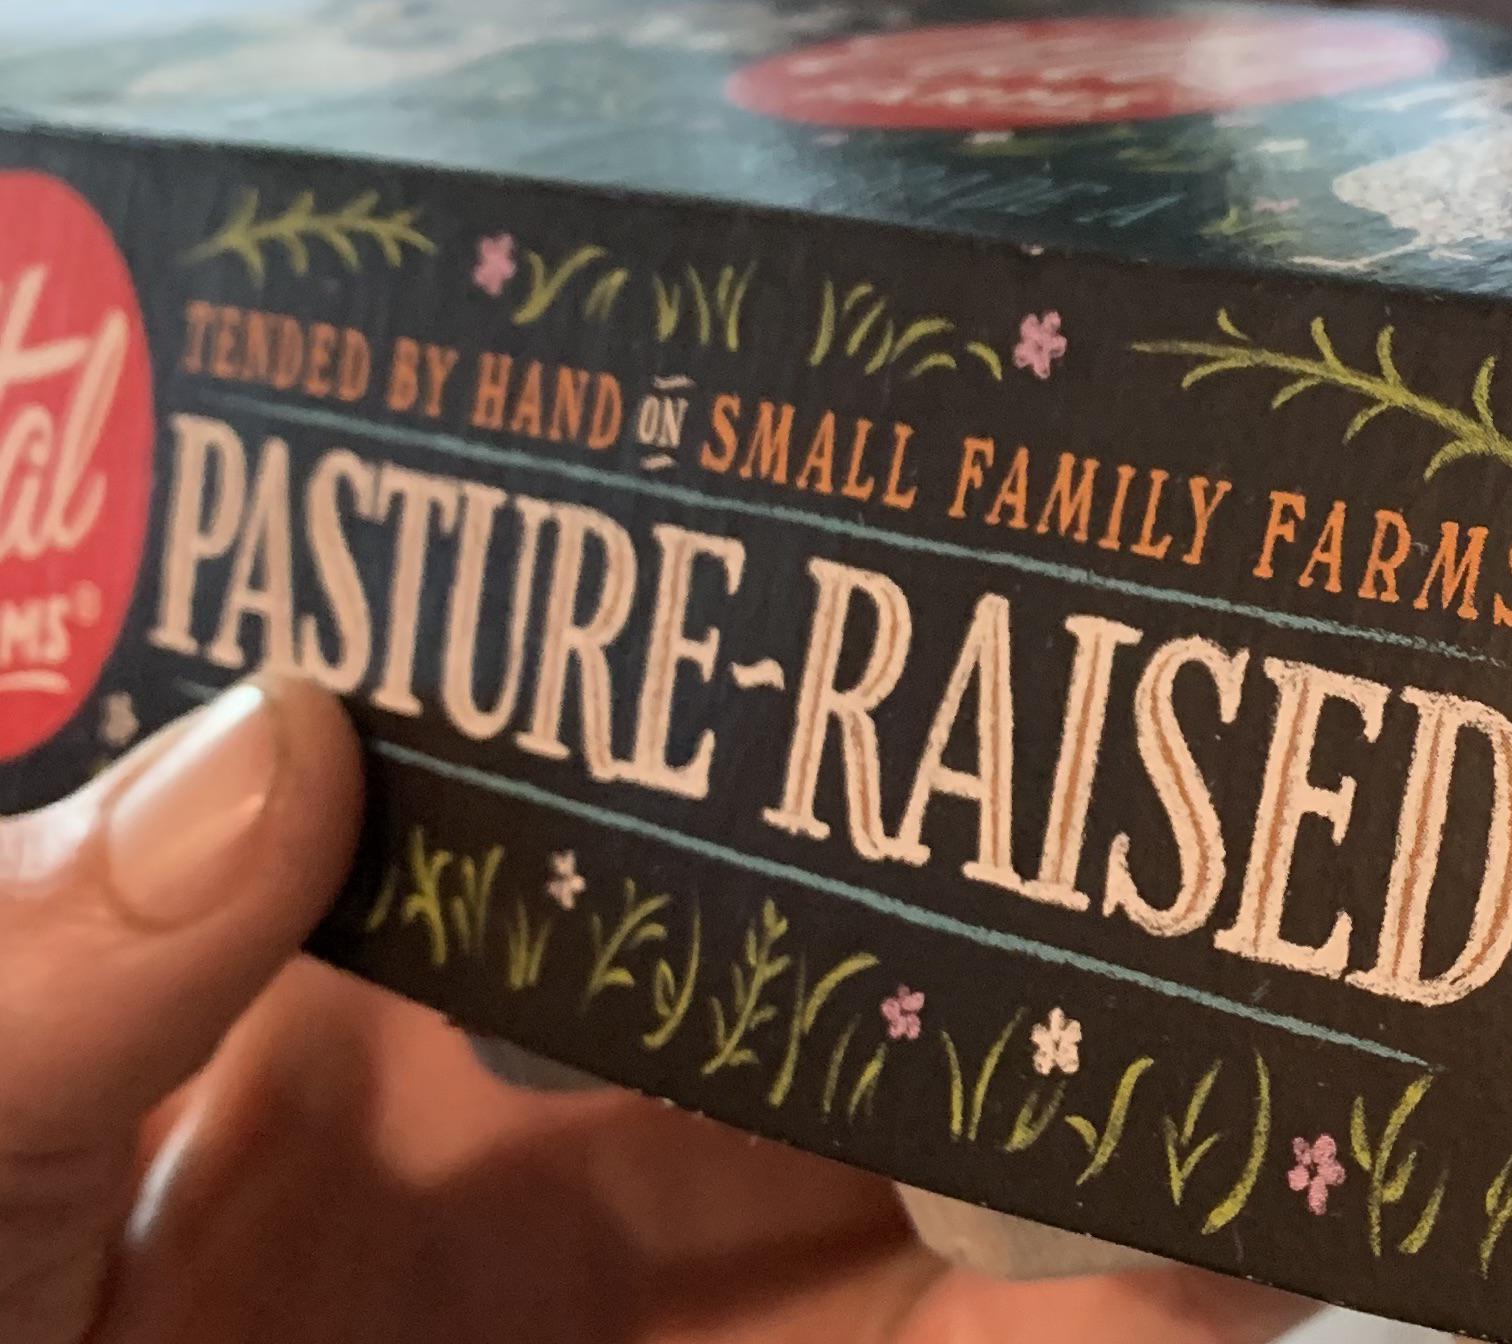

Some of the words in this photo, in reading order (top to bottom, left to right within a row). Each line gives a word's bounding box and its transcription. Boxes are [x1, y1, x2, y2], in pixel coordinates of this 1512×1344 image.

[184, 299, 371, 402] TENDED
[387, 335, 460, 419] BY
[470, 352, 624, 450] HAND
[637, 394, 689, 448] ON
[702, 394, 922, 509] SMALL
[947, 437, 1232, 567] FAMILY
